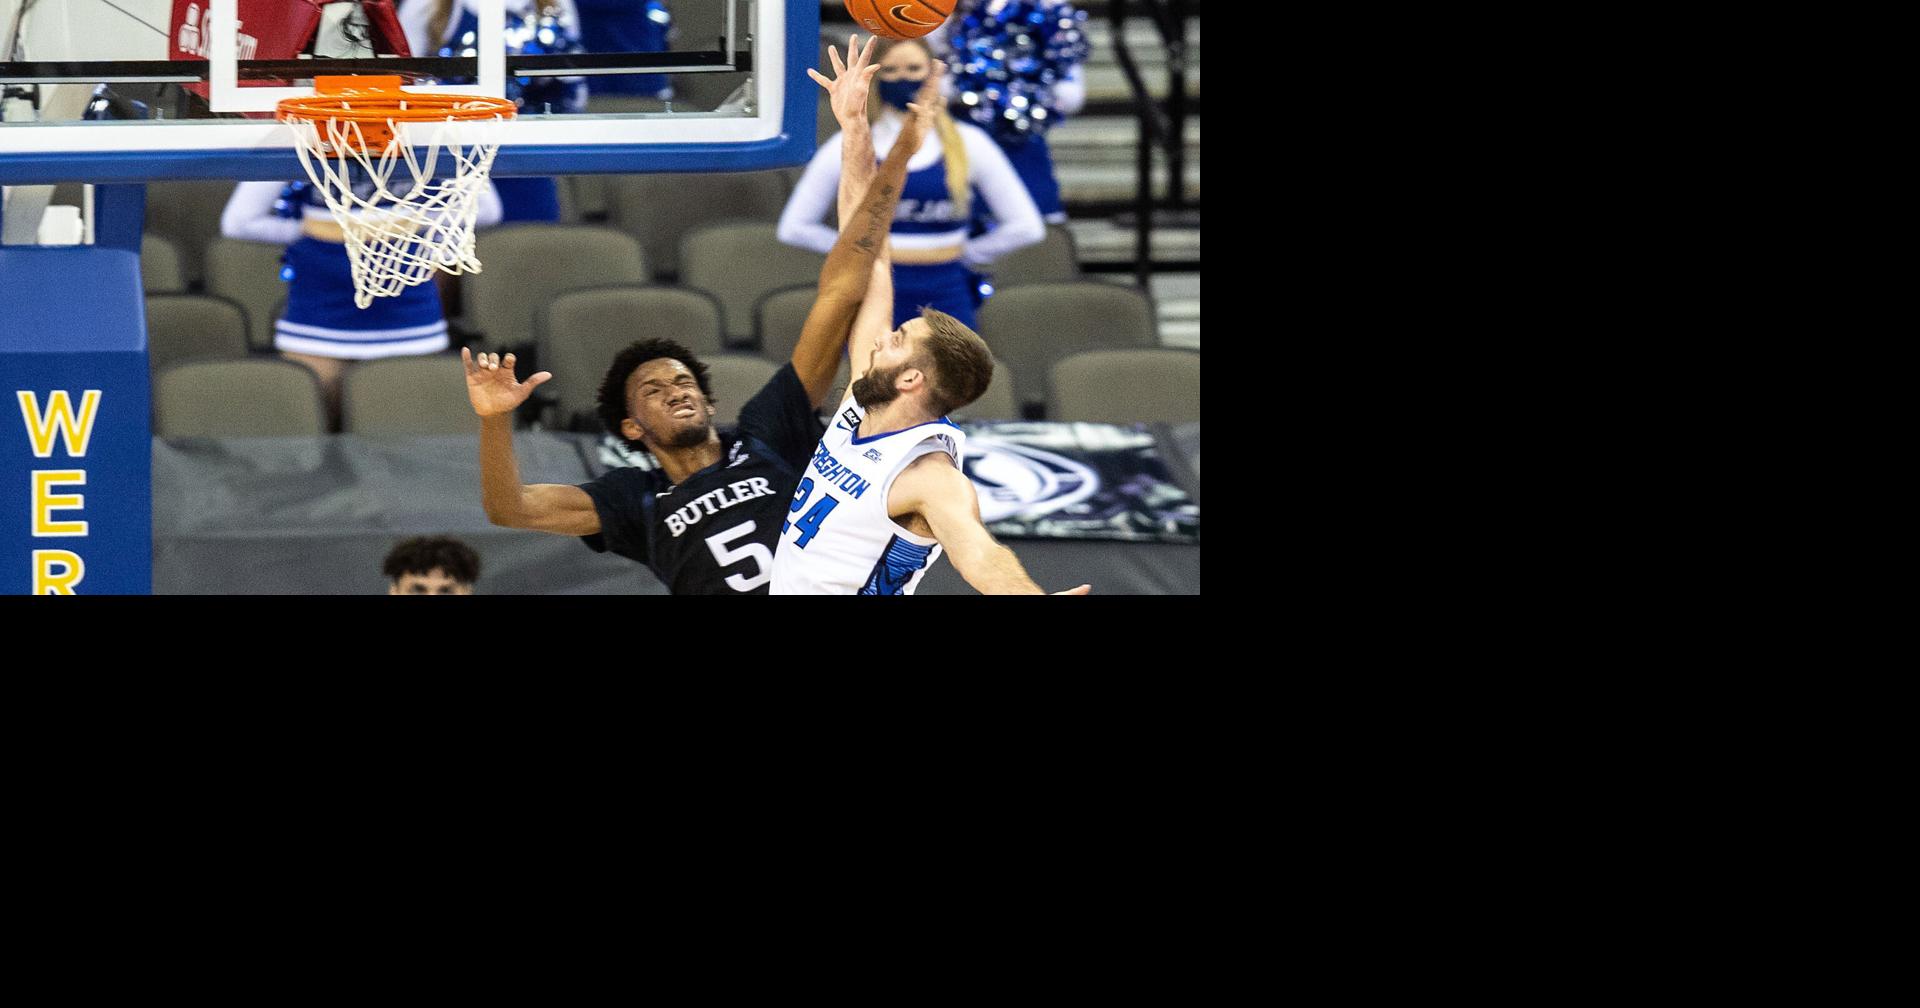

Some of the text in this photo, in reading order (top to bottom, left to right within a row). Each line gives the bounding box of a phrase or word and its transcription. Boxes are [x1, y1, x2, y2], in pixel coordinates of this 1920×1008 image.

[16, 389, 102, 595] WER
[664, 477, 776, 537] BUTLER
[782, 476, 840, 550] 24
[704, 519, 775, 592] 5
